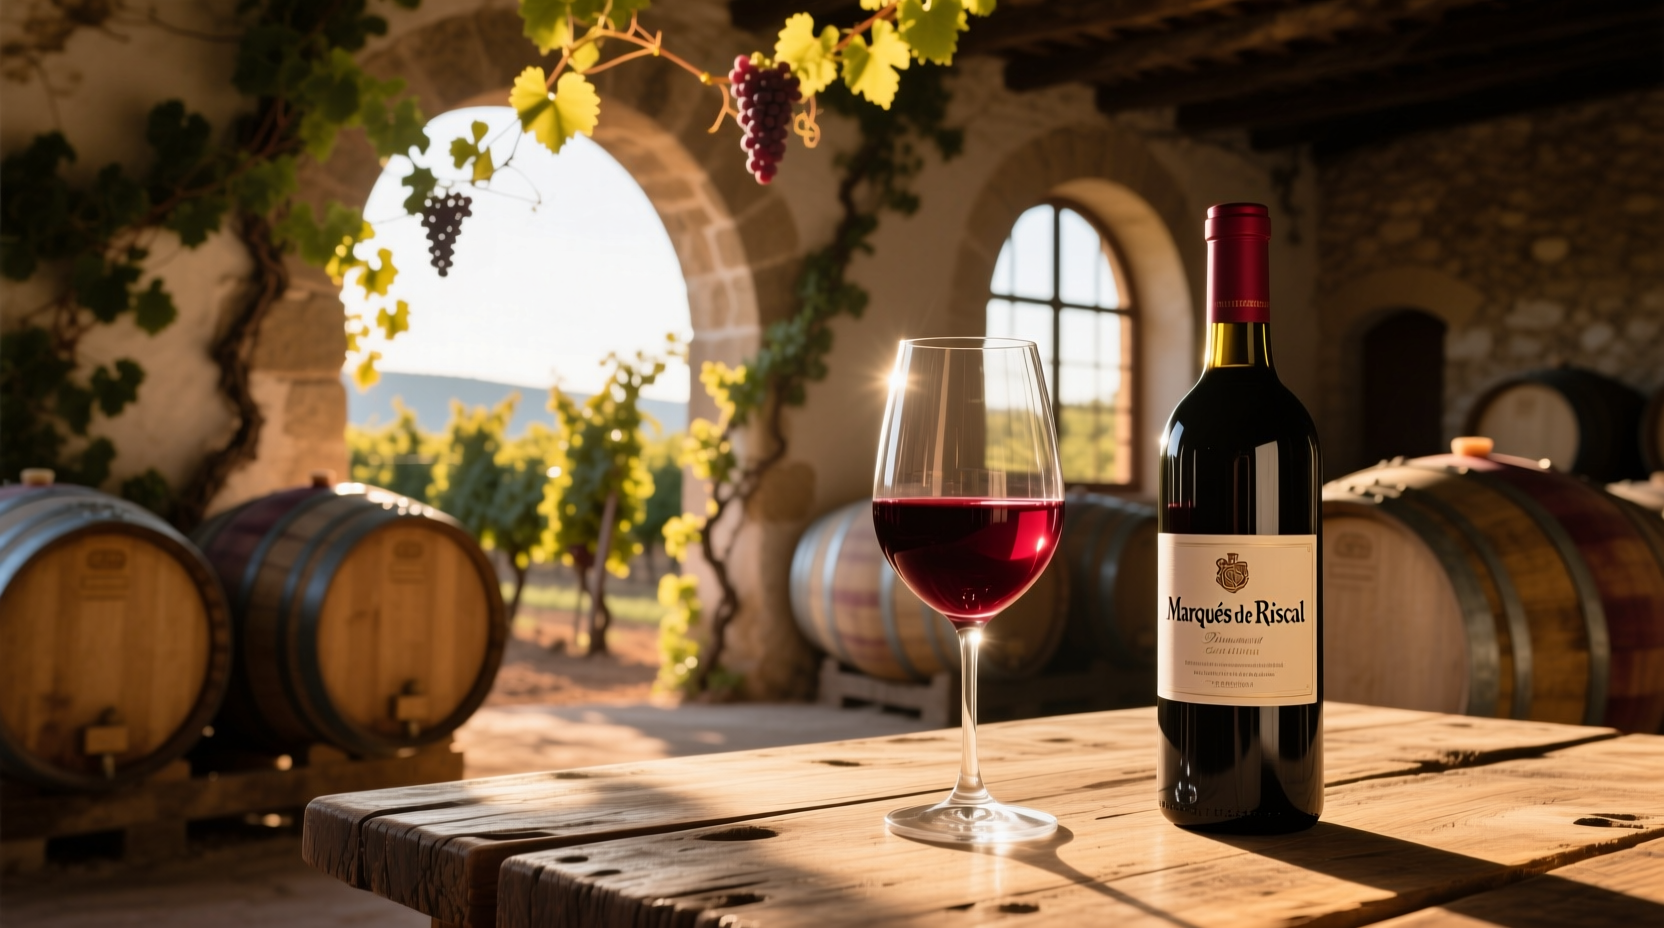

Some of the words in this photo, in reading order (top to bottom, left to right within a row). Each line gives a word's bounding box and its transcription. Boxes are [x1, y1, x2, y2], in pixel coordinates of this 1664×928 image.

[1167, 596, 1232, 629] Marqués
[1234, 604, 1253, 624] de
[1254, 600, 1305, 626] Riscal
